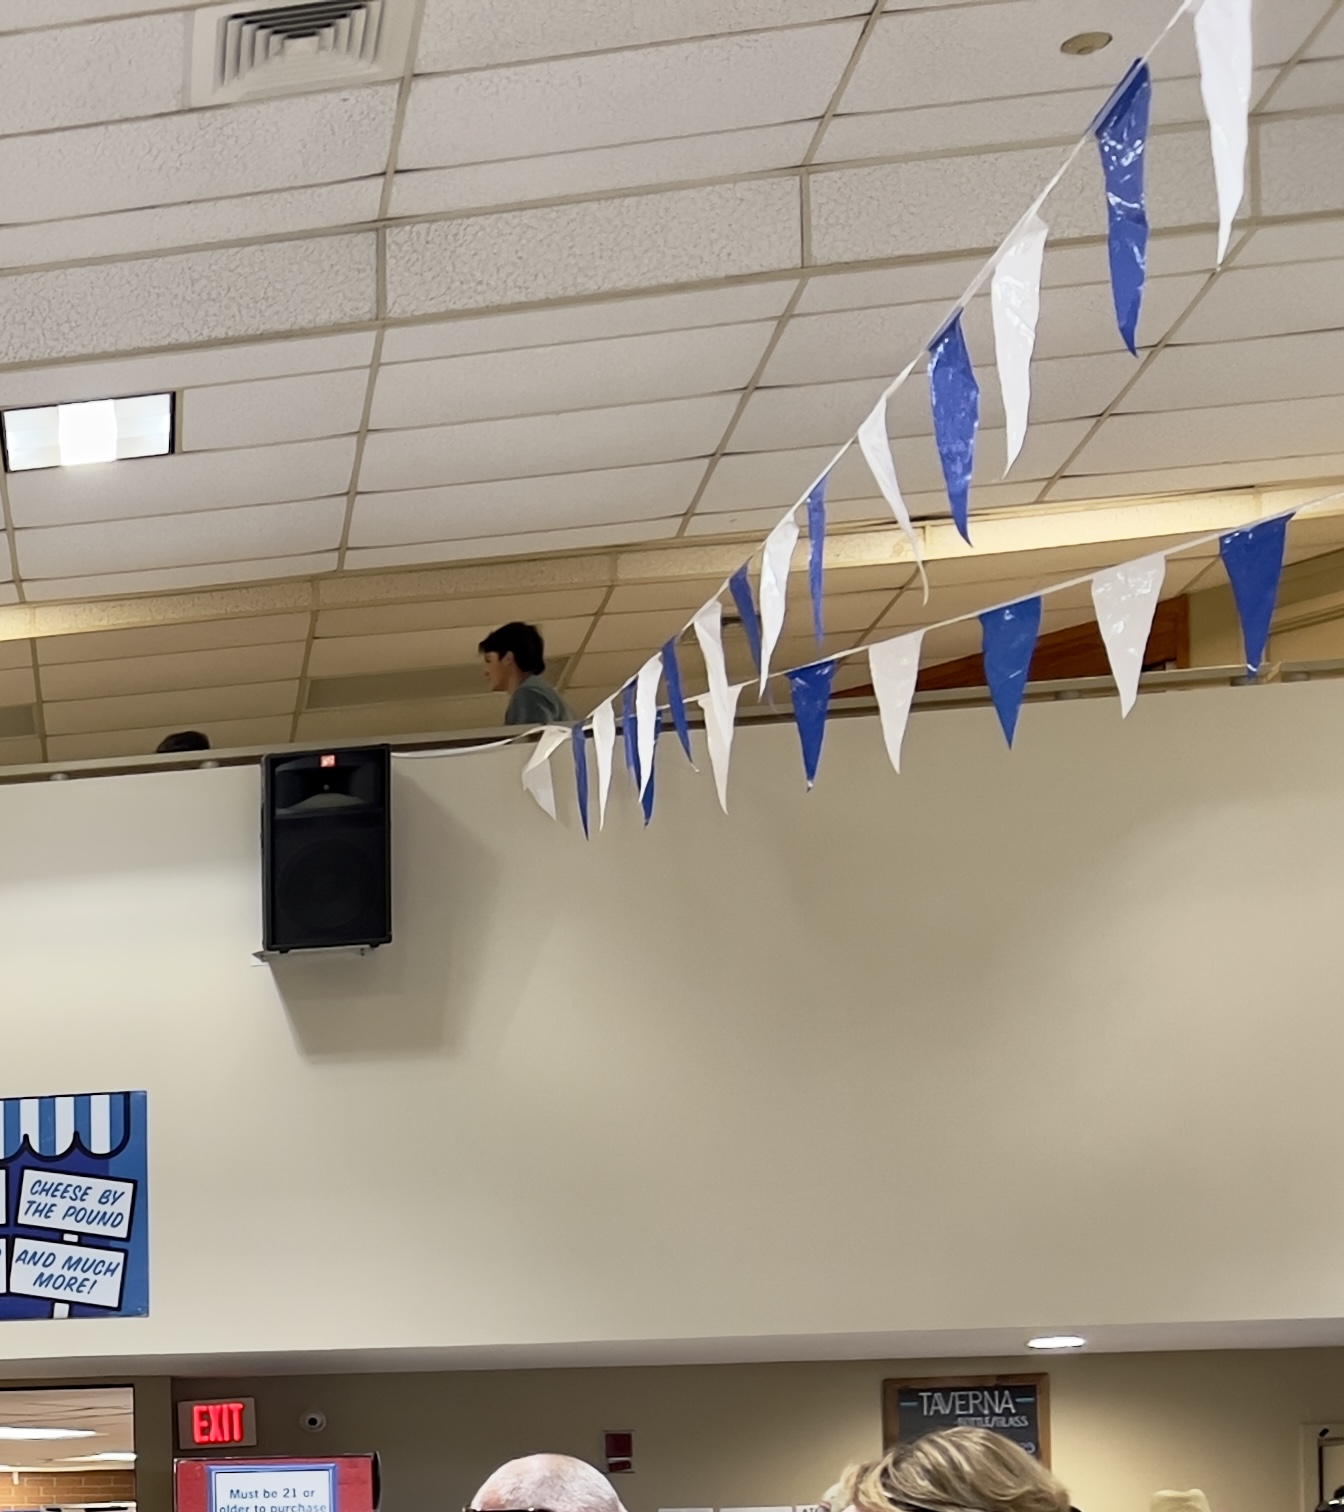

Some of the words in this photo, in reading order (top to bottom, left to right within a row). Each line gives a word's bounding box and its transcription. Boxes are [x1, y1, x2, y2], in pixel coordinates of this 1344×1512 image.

[29, 1179, 93, 1203] CHEESE
[98, 1189, 126, 1207] BY
[23, 1200, 56, 1219] THE
[62, 1205, 125, 1230] POUND
[14, 1249, 57, 1269] AND
[61, 1255, 122, 1278] MUCH
[33, 1271, 98, 1296] MORE!
[918, 1390, 1016, 1416] TAVERNA
[193, 1403, 244, 1443] EXIT
[229, 1488, 259, 1500] Must
[263, 1488, 278, 1499] be
[282, 1488, 297, 1498] 21
[303, 1489, 315, 1498] or
